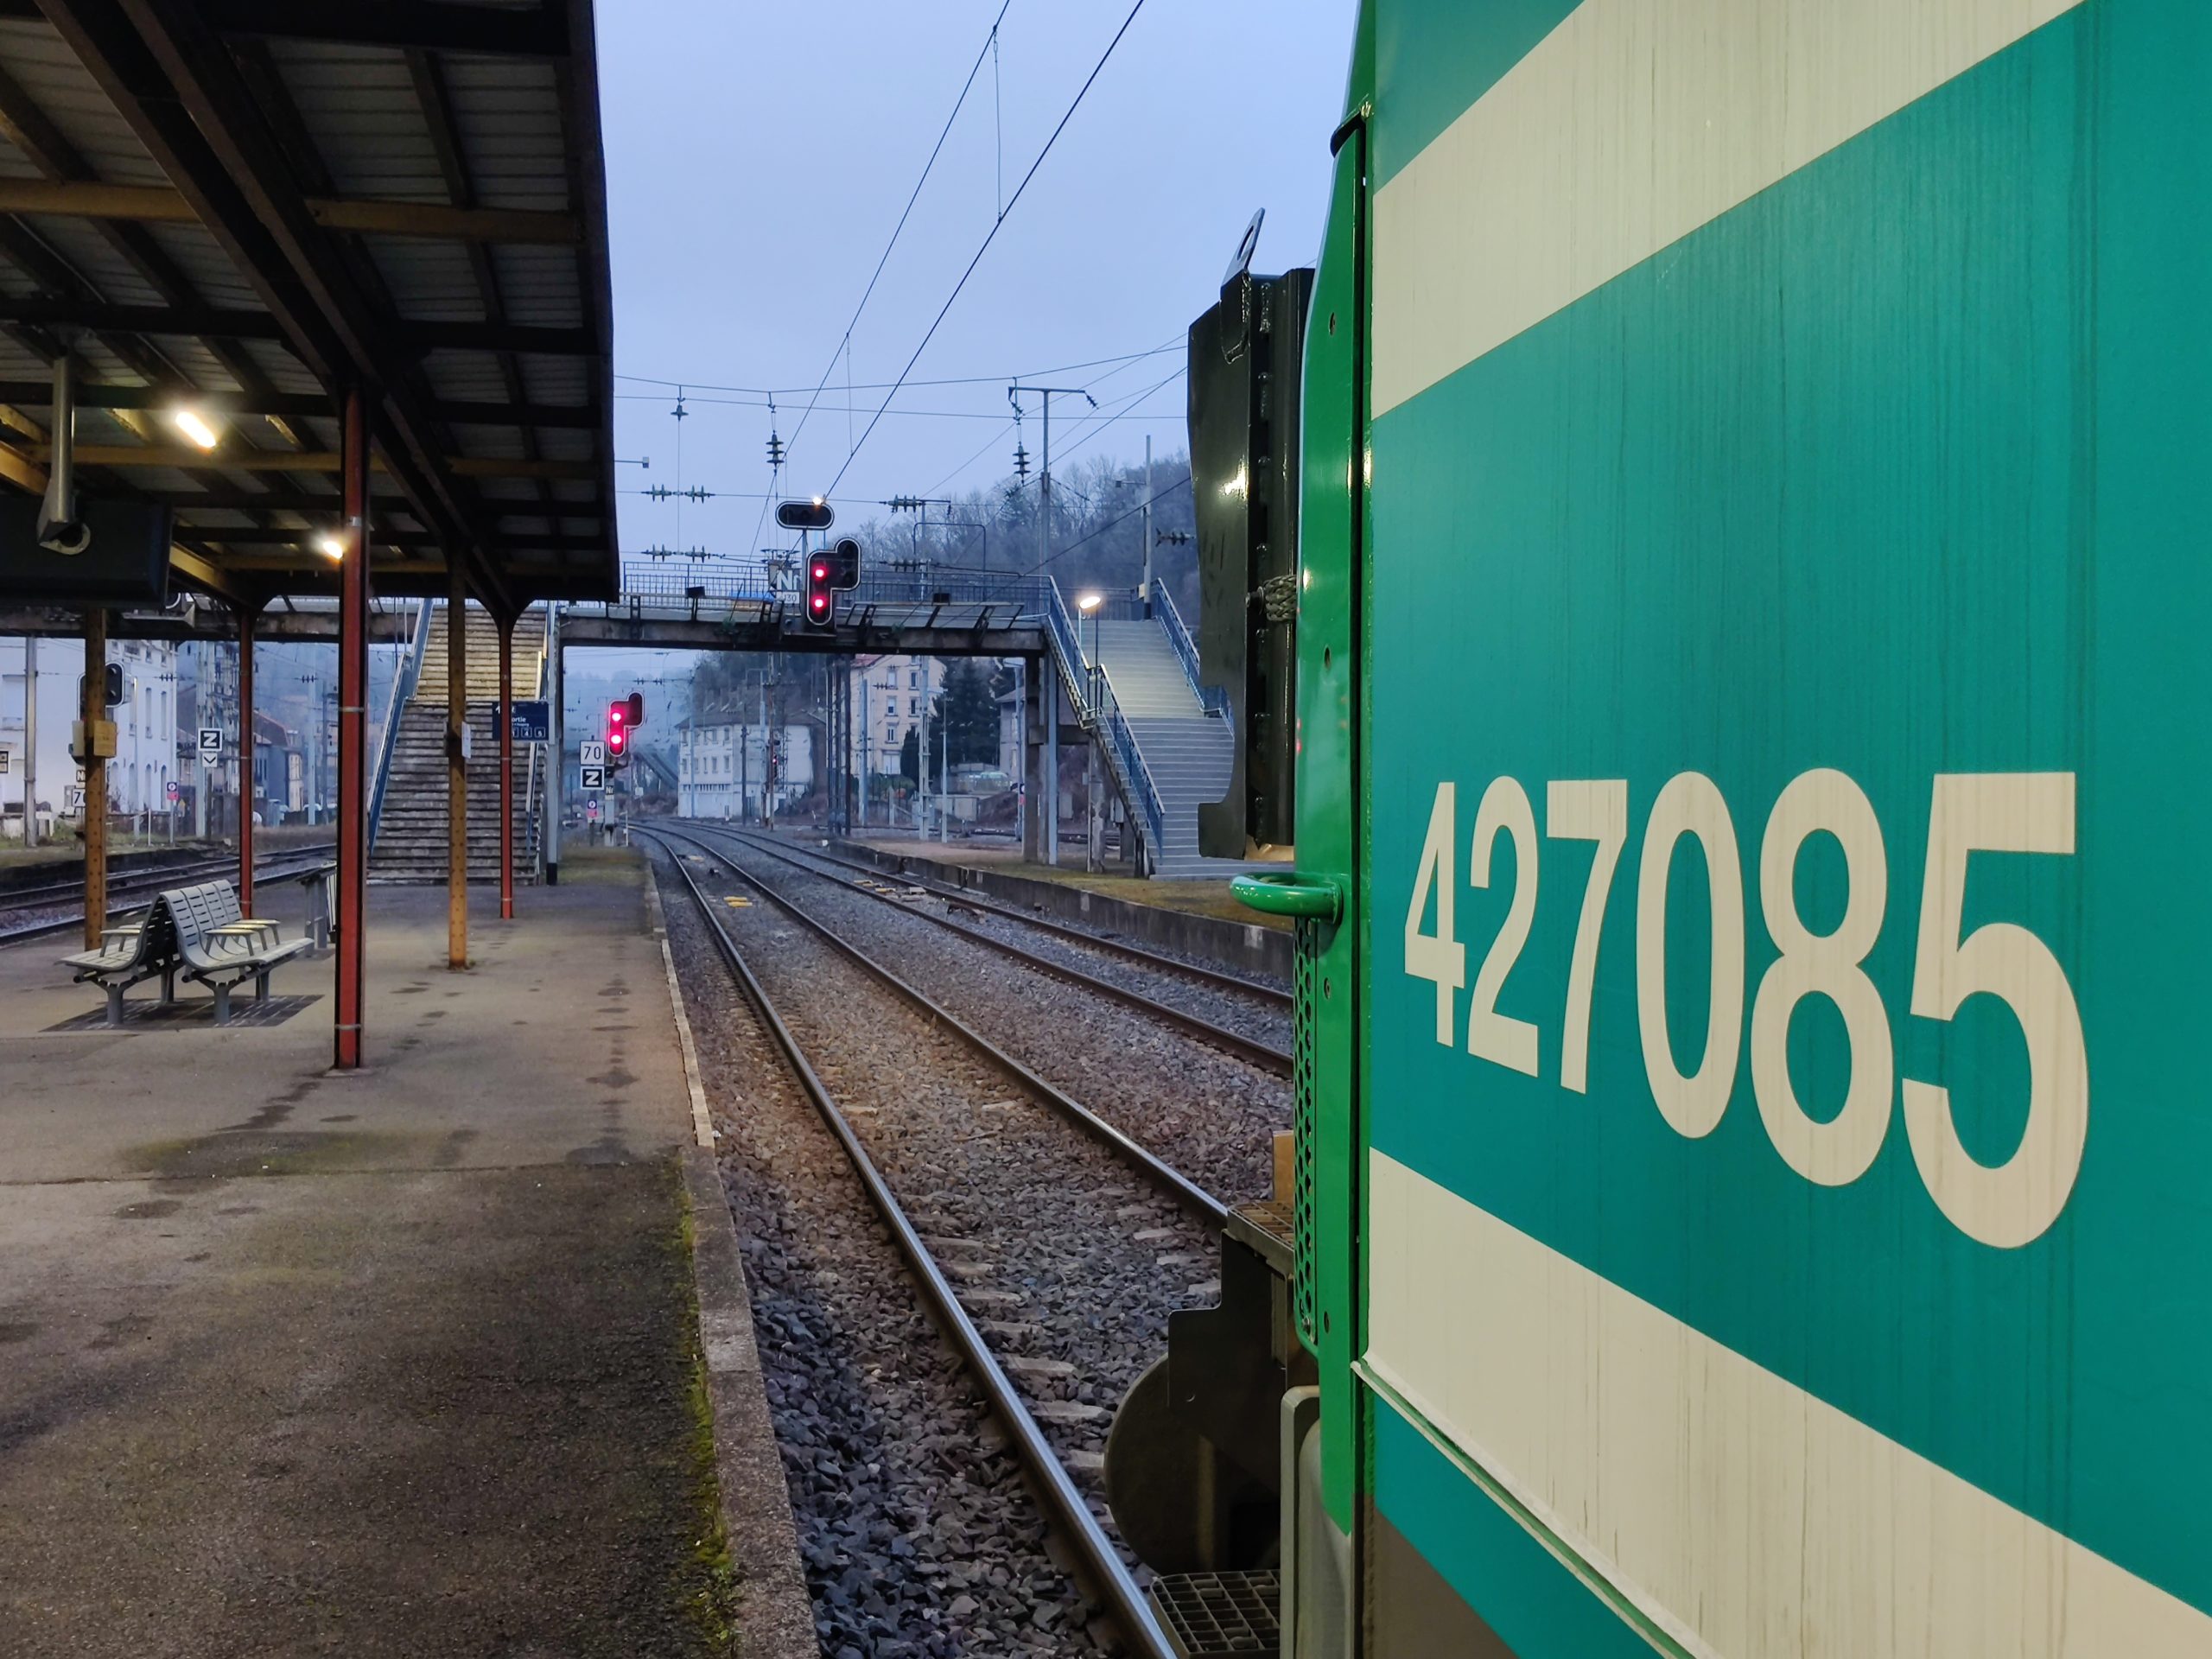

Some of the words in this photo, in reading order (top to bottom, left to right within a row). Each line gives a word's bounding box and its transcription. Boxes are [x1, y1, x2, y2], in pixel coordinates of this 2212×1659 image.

[203, 732, 218, 747] Z
[584, 746, 601, 760] 70
[585, 771, 600, 785] Z
[1404, 767, 2088, 1249] 427085
